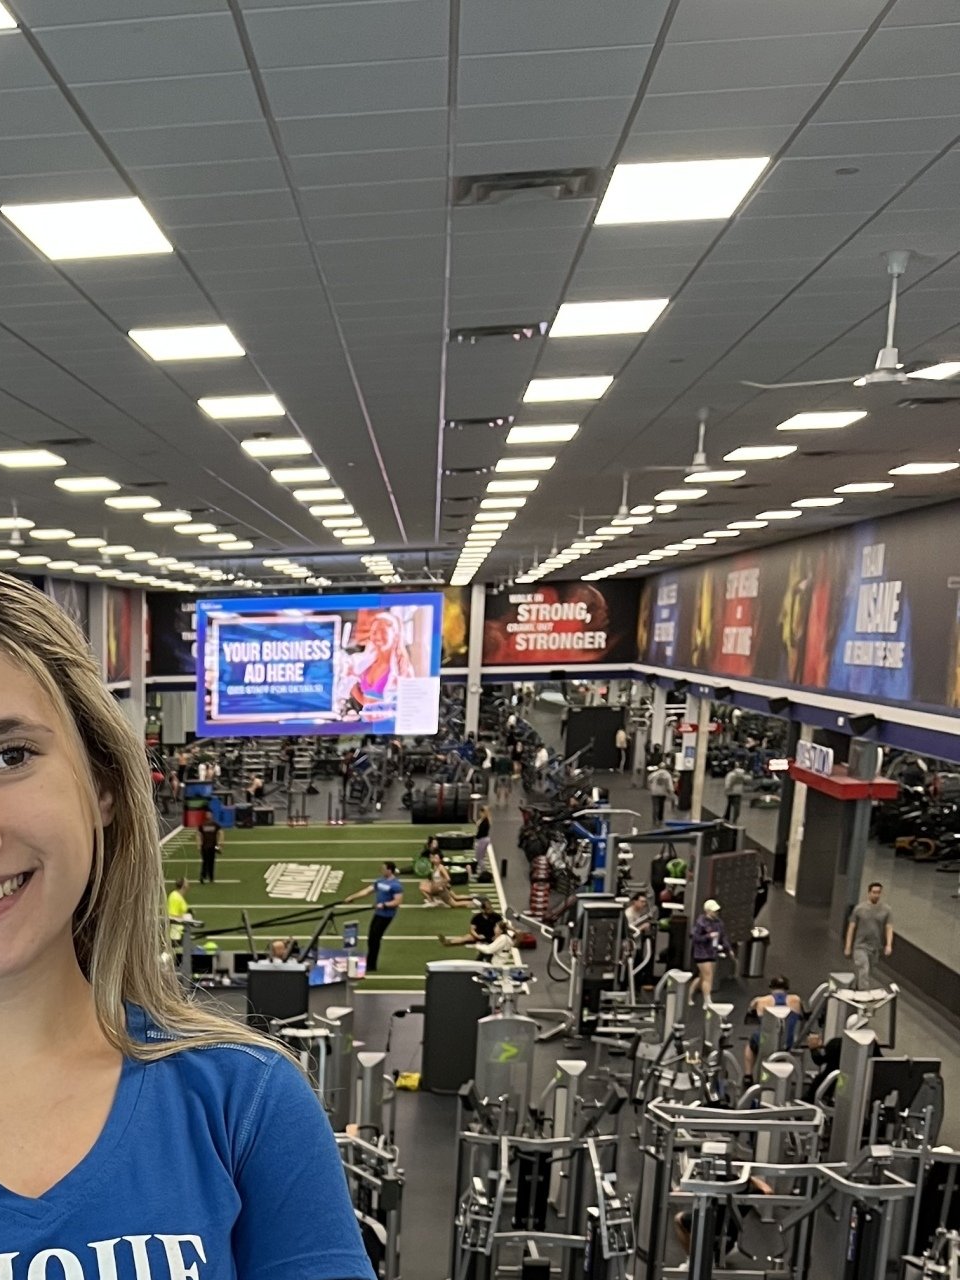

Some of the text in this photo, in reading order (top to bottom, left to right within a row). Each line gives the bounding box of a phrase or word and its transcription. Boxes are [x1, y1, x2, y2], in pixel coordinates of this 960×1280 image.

[516, 602, 592, 624] STRONG,
[222, 639, 332, 663] YOUR BUSINESS
[515, 631, 607, 651] STRONGER
[243, 662, 305, 684] AD HERE
